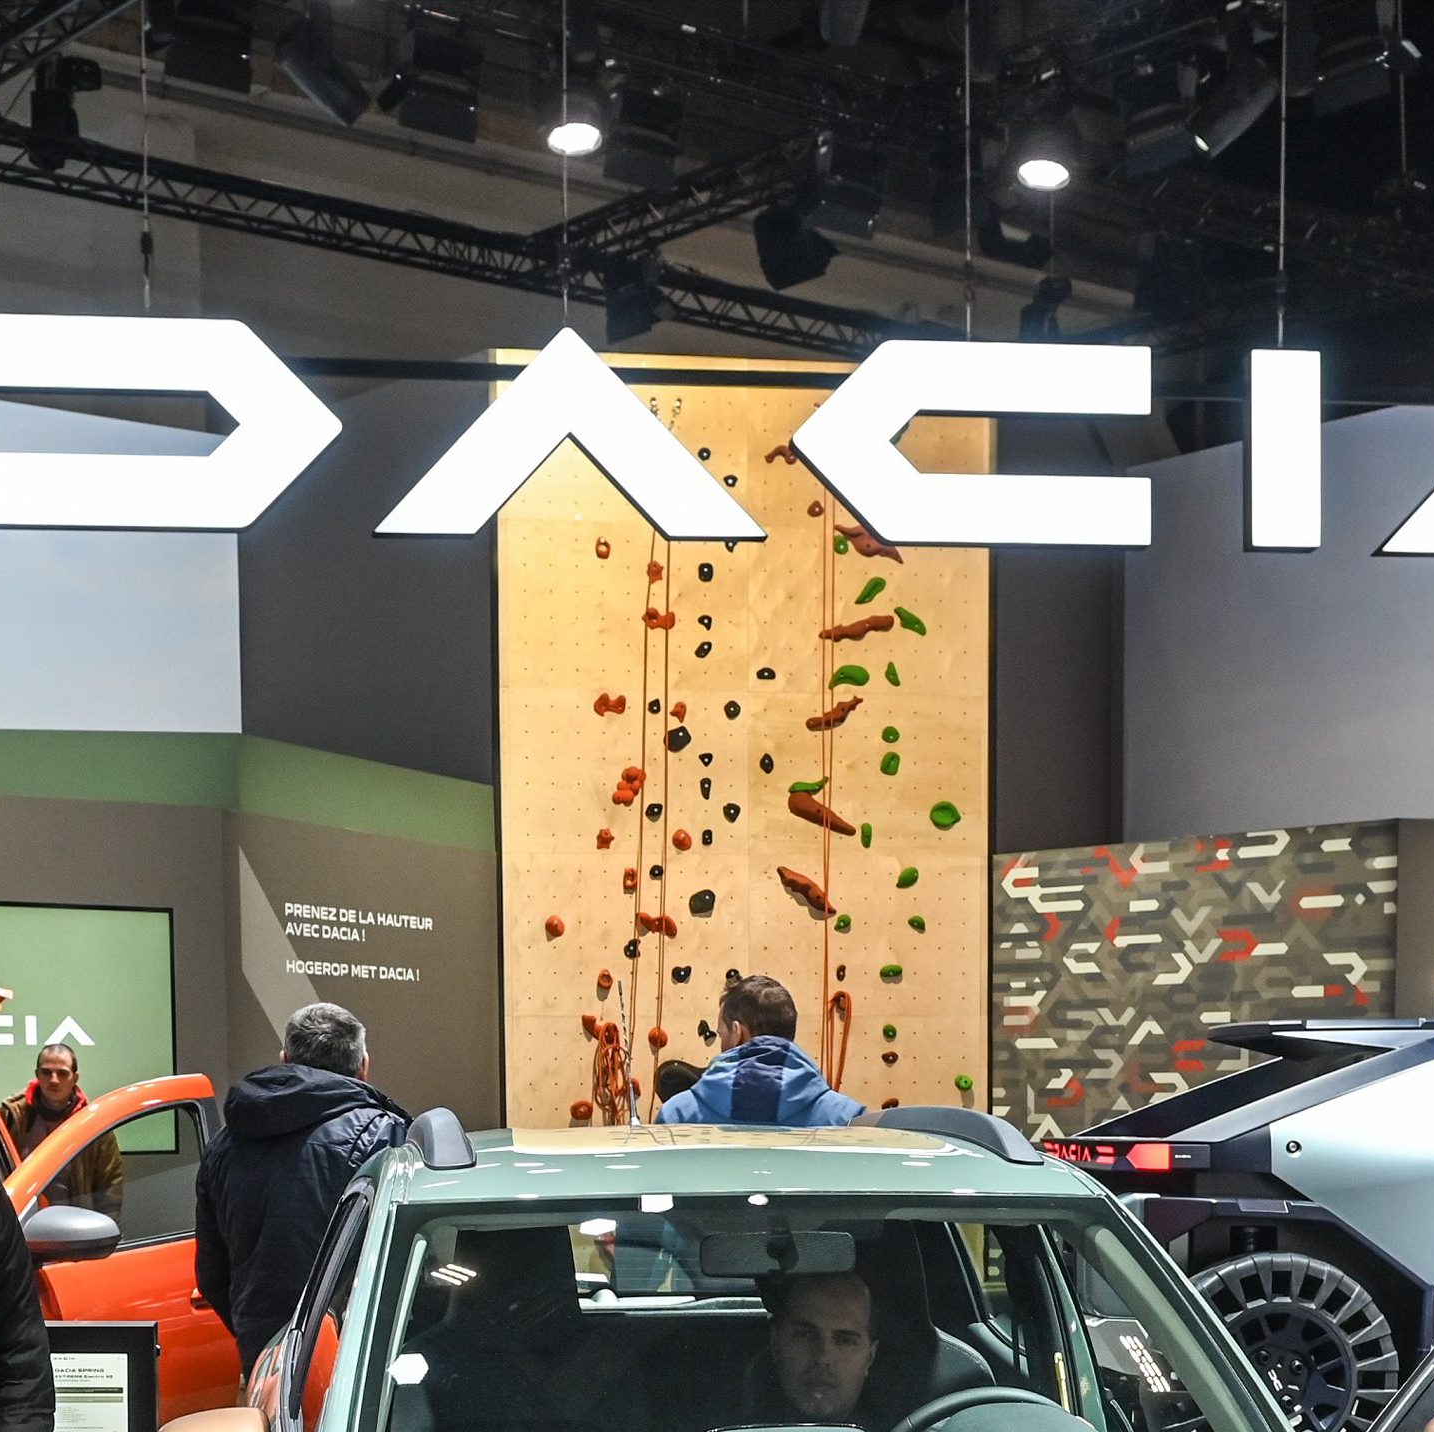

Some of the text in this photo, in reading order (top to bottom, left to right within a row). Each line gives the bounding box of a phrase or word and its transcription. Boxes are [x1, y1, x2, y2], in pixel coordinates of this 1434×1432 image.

[284, 902, 433, 930] PRENEZ DE LA HAUTEUR
[285, 922, 365, 942] AVEC DACIA !
[286, 959, 419, 981] HOGEROP MET DACIA !
